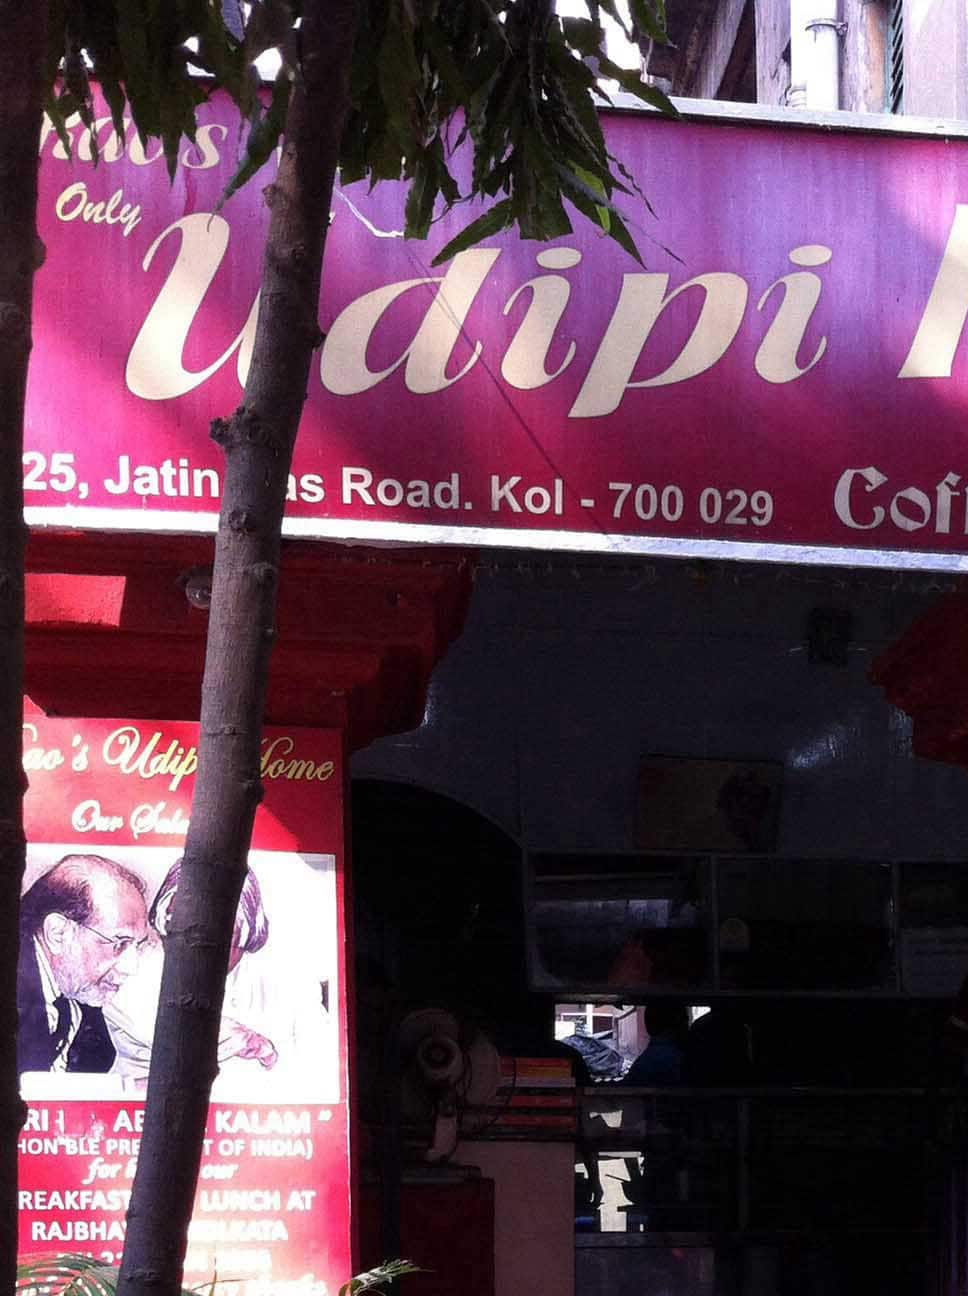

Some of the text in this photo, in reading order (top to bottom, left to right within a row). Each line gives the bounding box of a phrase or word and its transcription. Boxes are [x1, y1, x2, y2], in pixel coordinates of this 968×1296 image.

[56, 181, 142, 237] Only
[124, 212, 832, 419] Udipi
[22, 452, 90, 500] 25,
[104, 455, 221, 498] Jatin
[342, 466, 472, 512] Road.
[491, 474, 563, 515] Kol
[609, 482, 685, 522] 700
[699, 488, 774, 527] 029
[103, 726, 198, 792] Udip
[71, 799, 124, 832] Our
[218, 1140, 245, 1157] OF
[82, 1157, 122, 1185] for
[286, 1189, 317, 1212] AT
